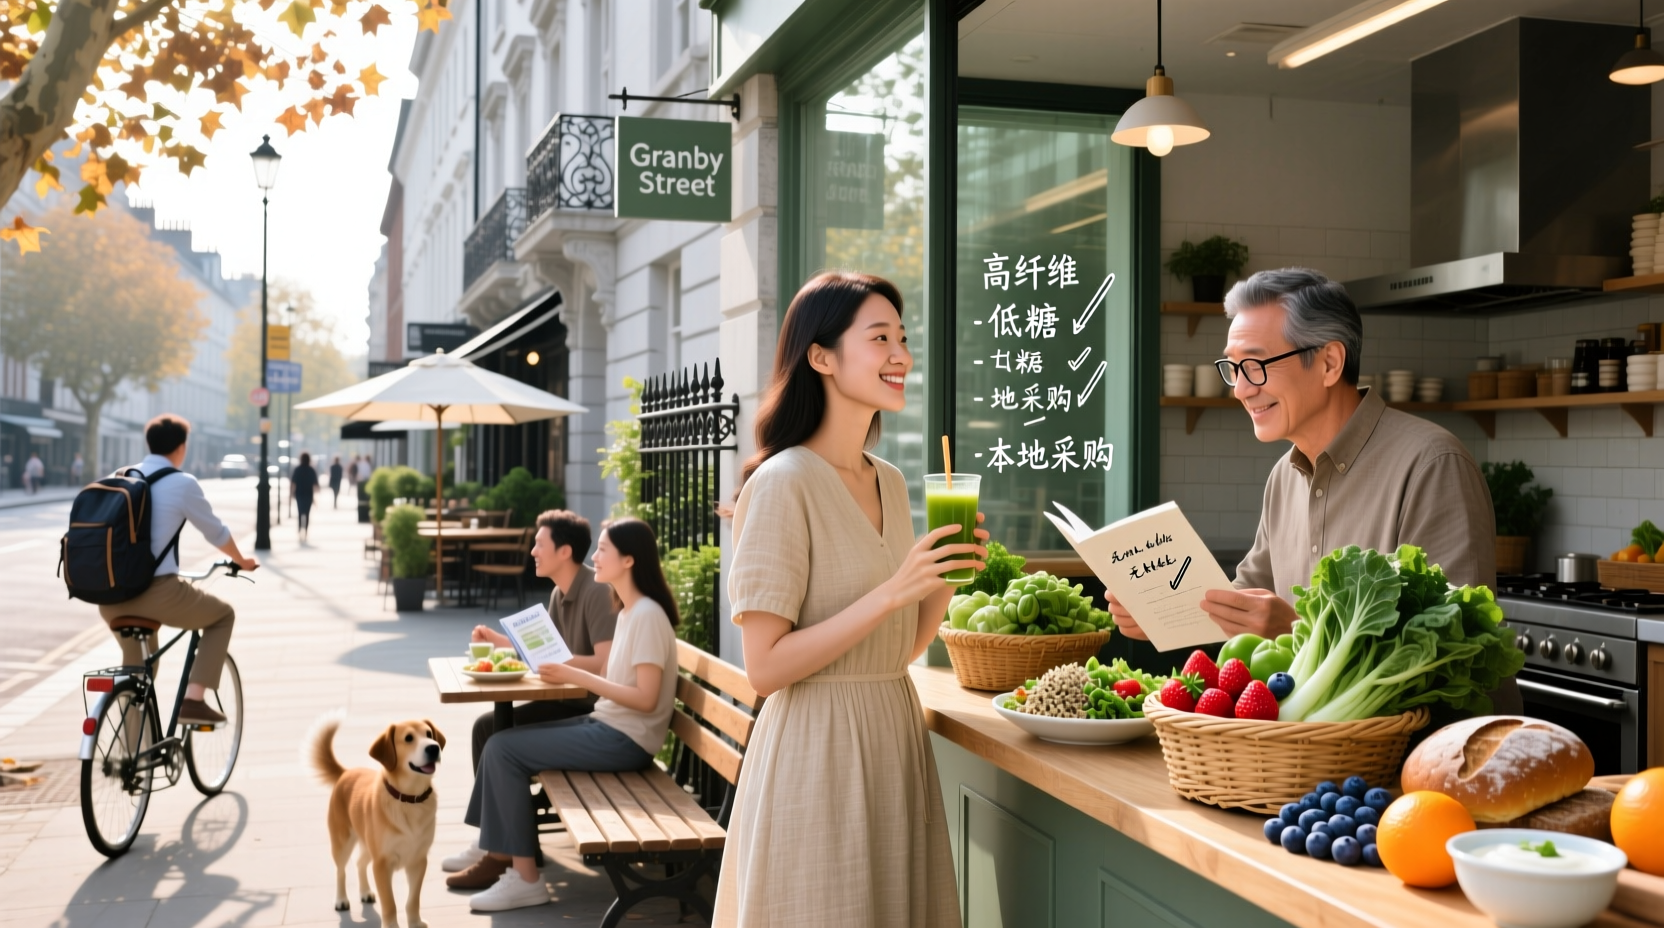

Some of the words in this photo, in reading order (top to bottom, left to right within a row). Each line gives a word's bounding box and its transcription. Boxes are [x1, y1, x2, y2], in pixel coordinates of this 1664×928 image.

[630, 142, 724, 176] Granby
[639, 171, 716, 197] Street
[983, 253, 1079, 291] 高纤维
